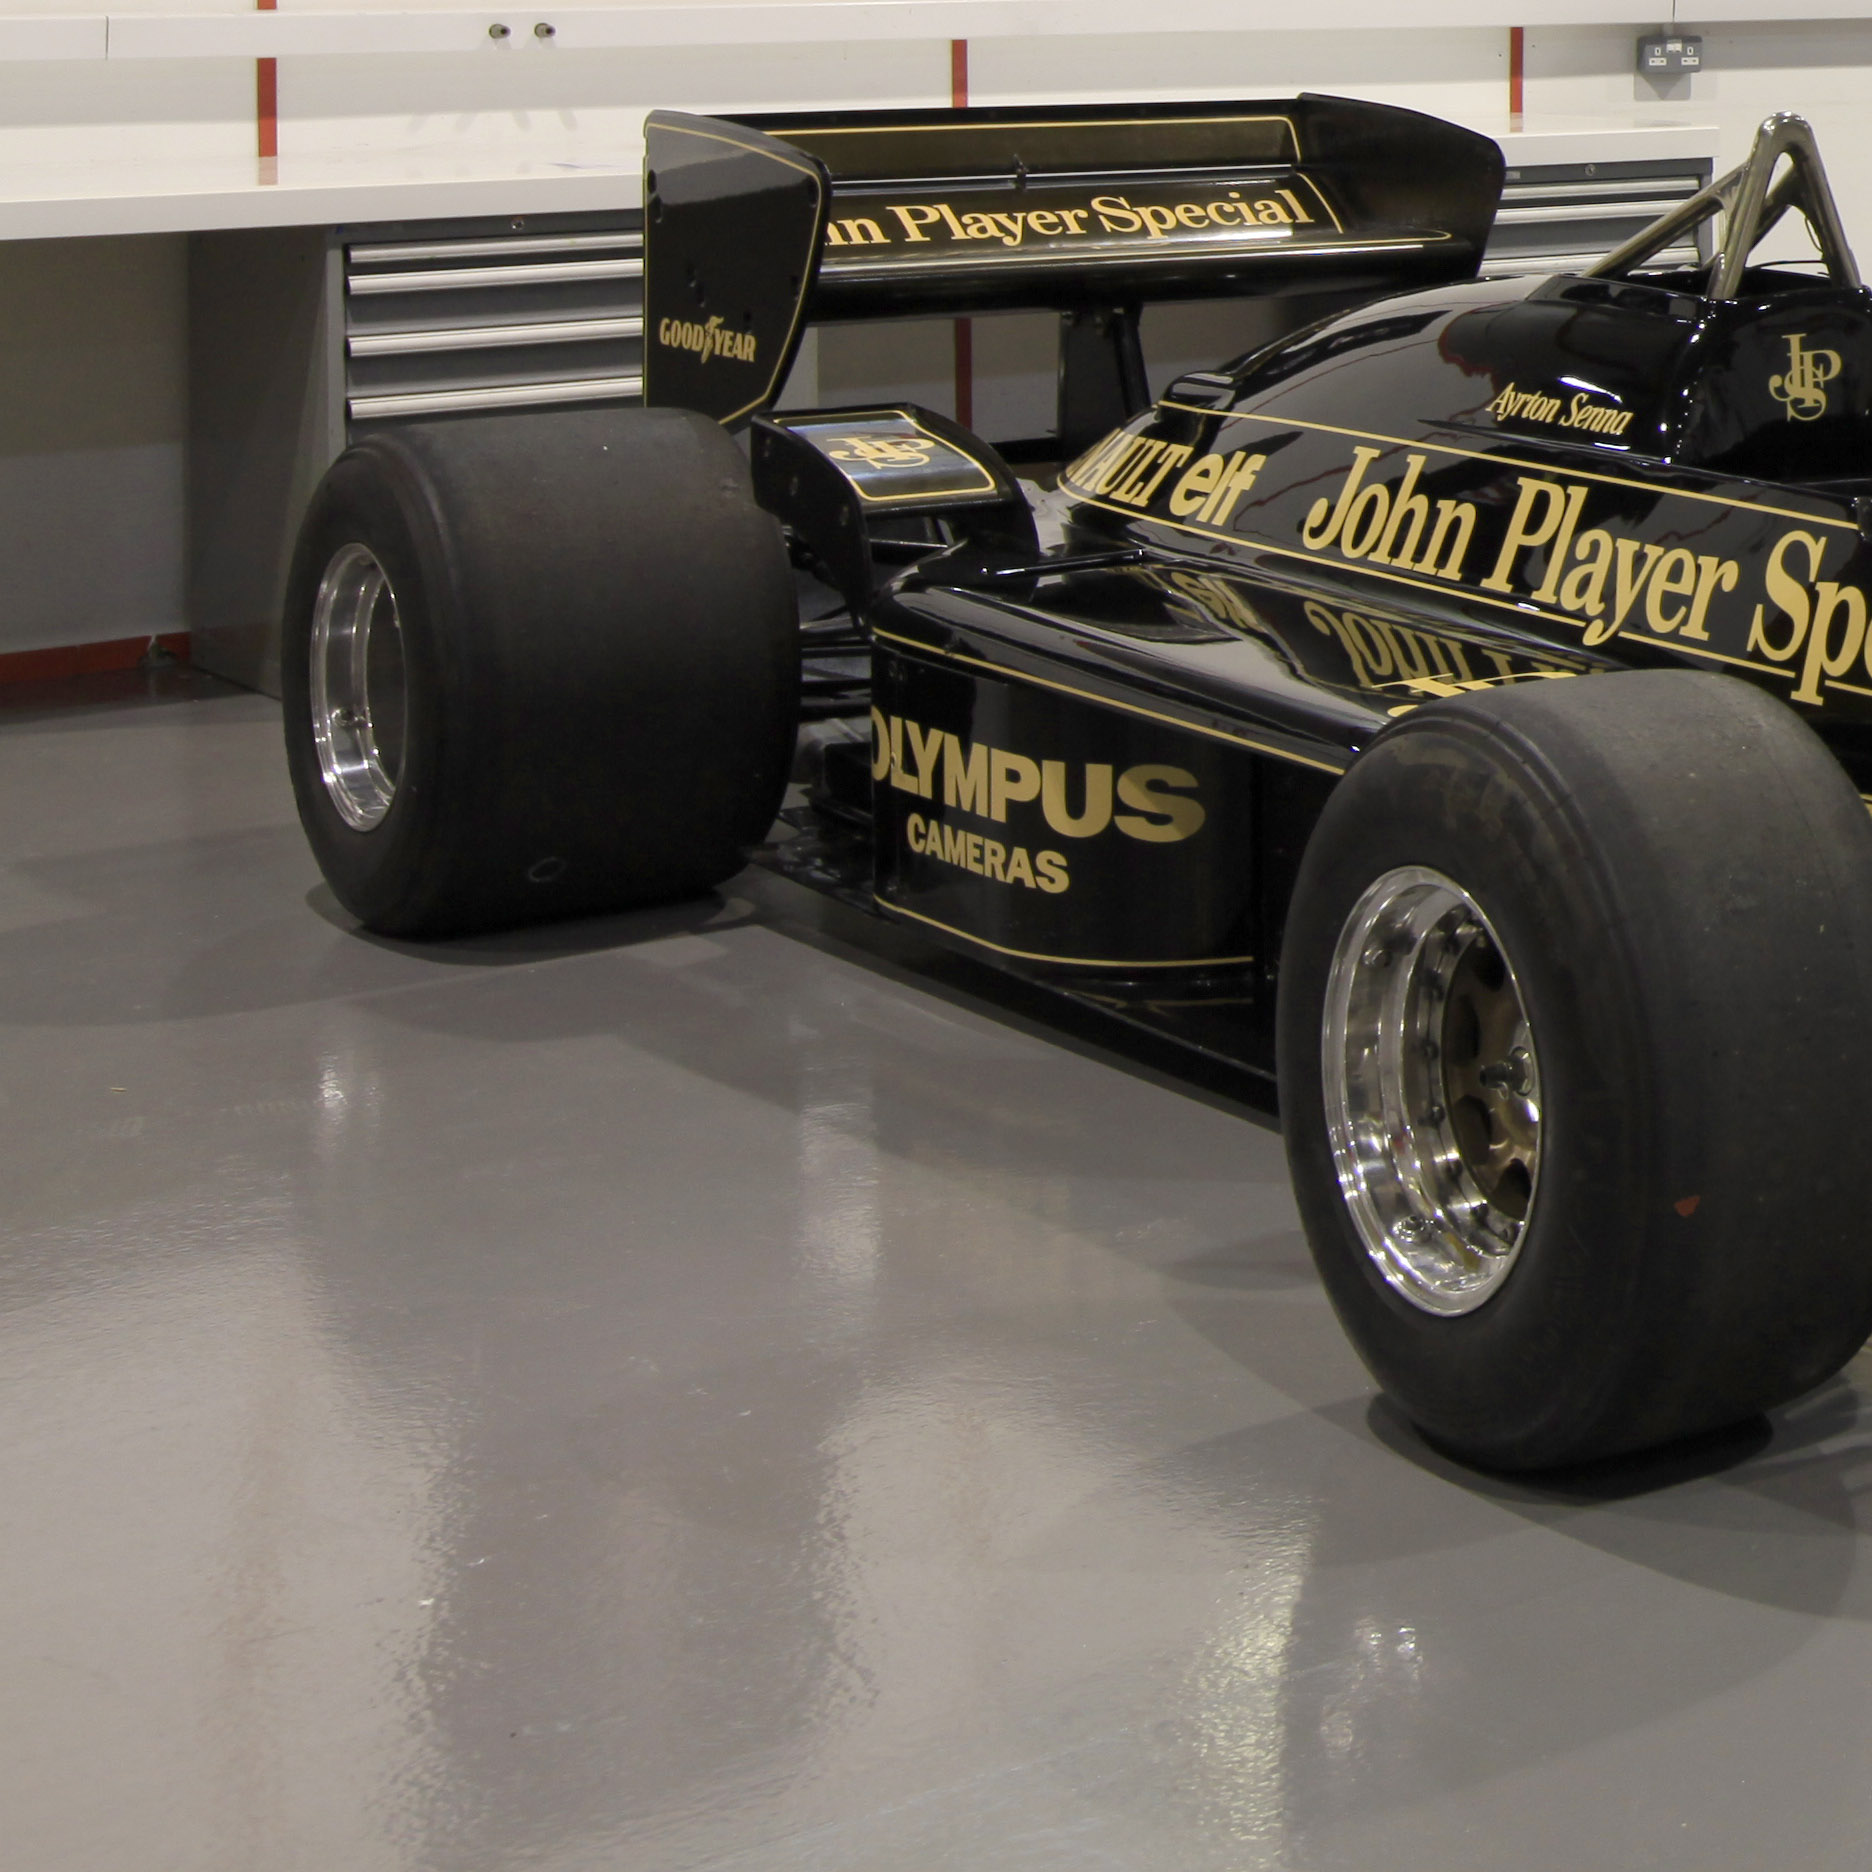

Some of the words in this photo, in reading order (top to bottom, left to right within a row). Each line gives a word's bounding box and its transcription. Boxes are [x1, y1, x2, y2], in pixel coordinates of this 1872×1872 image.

[887, 205, 1088, 247] Player
[1091, 189, 1315, 240] Special
[1486, 382, 1557, 424] Ayrton
[1560, 392, 1635, 436] Senna
[1169, 450, 1267, 526] elf
[1303, 445, 1475, 576] John
[1482, 474, 1740, 646] Player
[906, 812, 1070, 895] CAMERAS
